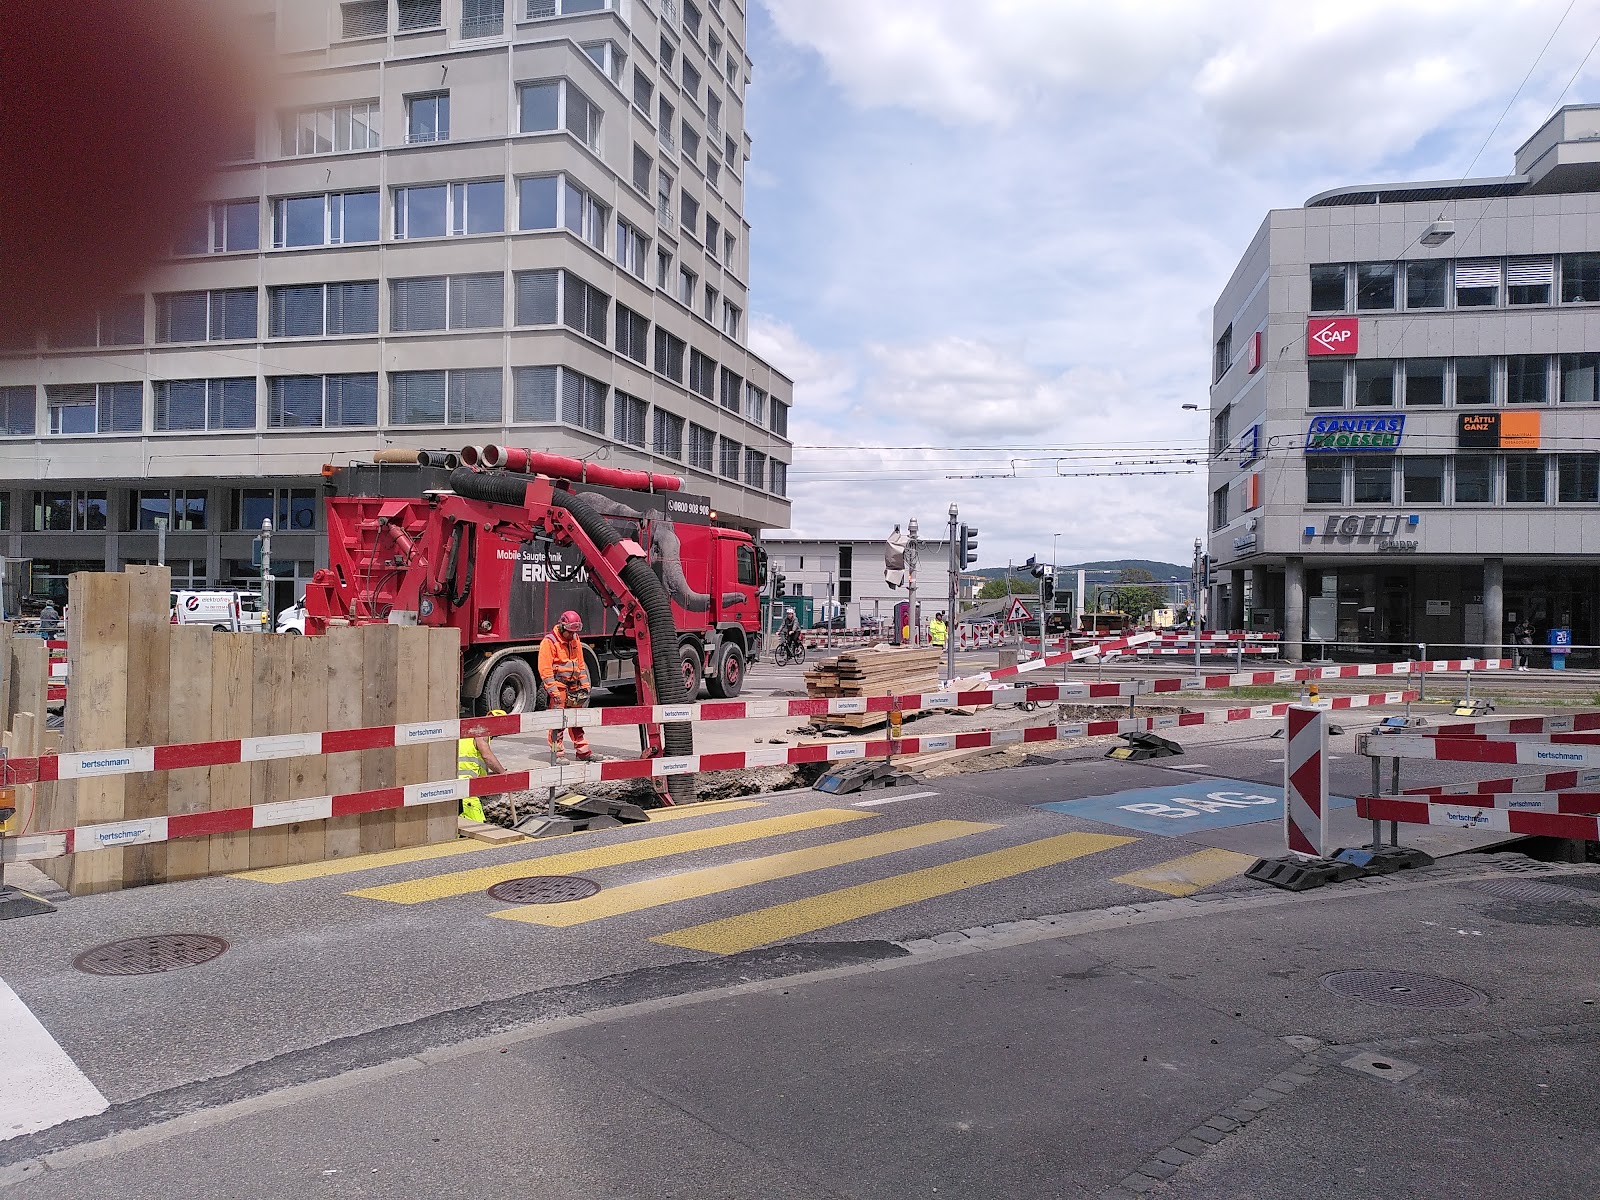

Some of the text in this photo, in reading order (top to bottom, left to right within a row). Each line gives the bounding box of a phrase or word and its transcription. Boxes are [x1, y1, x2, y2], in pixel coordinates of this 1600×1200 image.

[1321, 330, 1351, 342] CAP
[1464, 415, 1495, 424] PLÄTTLI
[1316, 419, 1399, 434] SANITAS
[1311, 433, 1396, 447] TROESCH
[673, 501, 710, 515] 0800 908 908
[1324, 514, 1401, 536] EGELI
[496, 549, 563, 563] Mobile Saugtehnik
[408, 728, 443, 737] bertschmann
[1537, 750, 1583, 761] bertschmann
[81, 758, 130, 769] bertschmann
[420, 788, 454, 798] bertschmann
